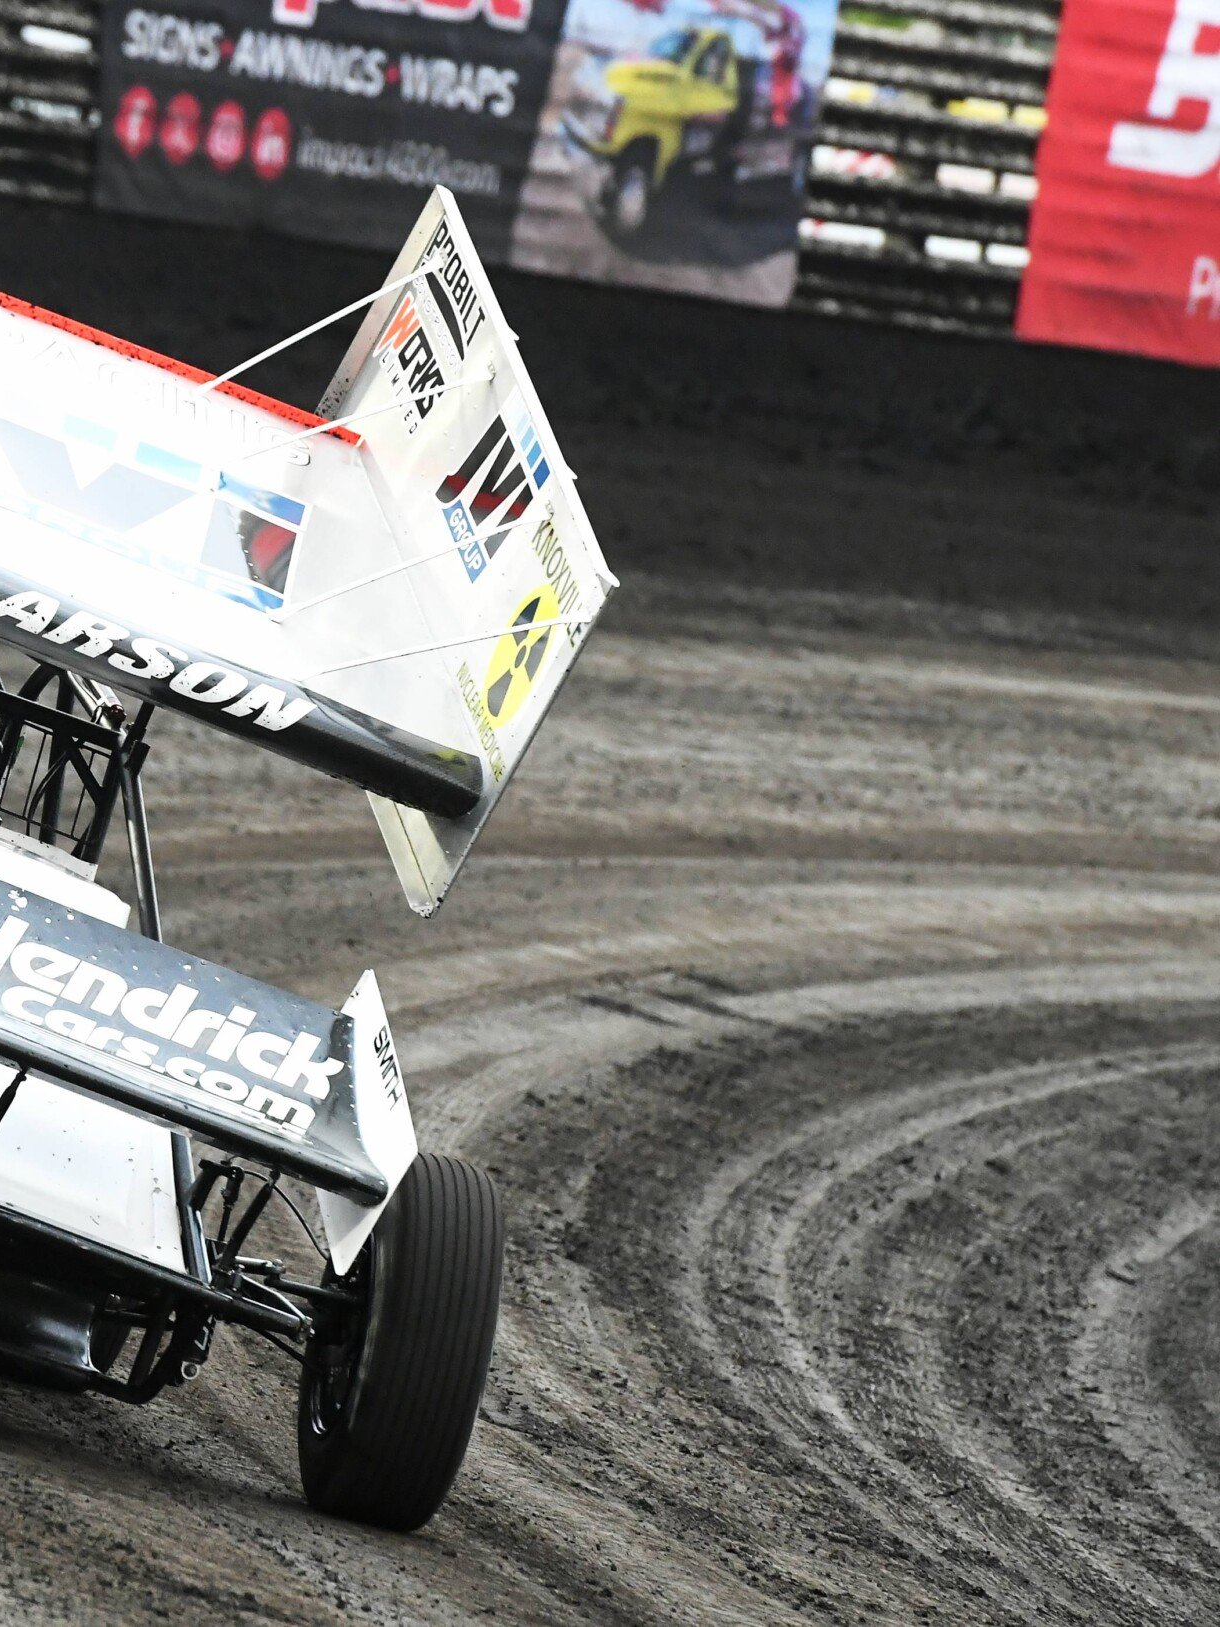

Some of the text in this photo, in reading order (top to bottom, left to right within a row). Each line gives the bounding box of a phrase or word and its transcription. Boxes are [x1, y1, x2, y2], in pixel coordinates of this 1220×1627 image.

[121, 9, 224, 71] SIGNS
[229, 28, 388, 98] AWNINGS
[398, 51, 520, 118] WRAPS
[382, 352, 418, 435] LIMIED
[448, 507, 482, 577] GROUP
[456, 661, 484, 726] NUCLEAR
[373, 1025, 402, 1111] SMITH
